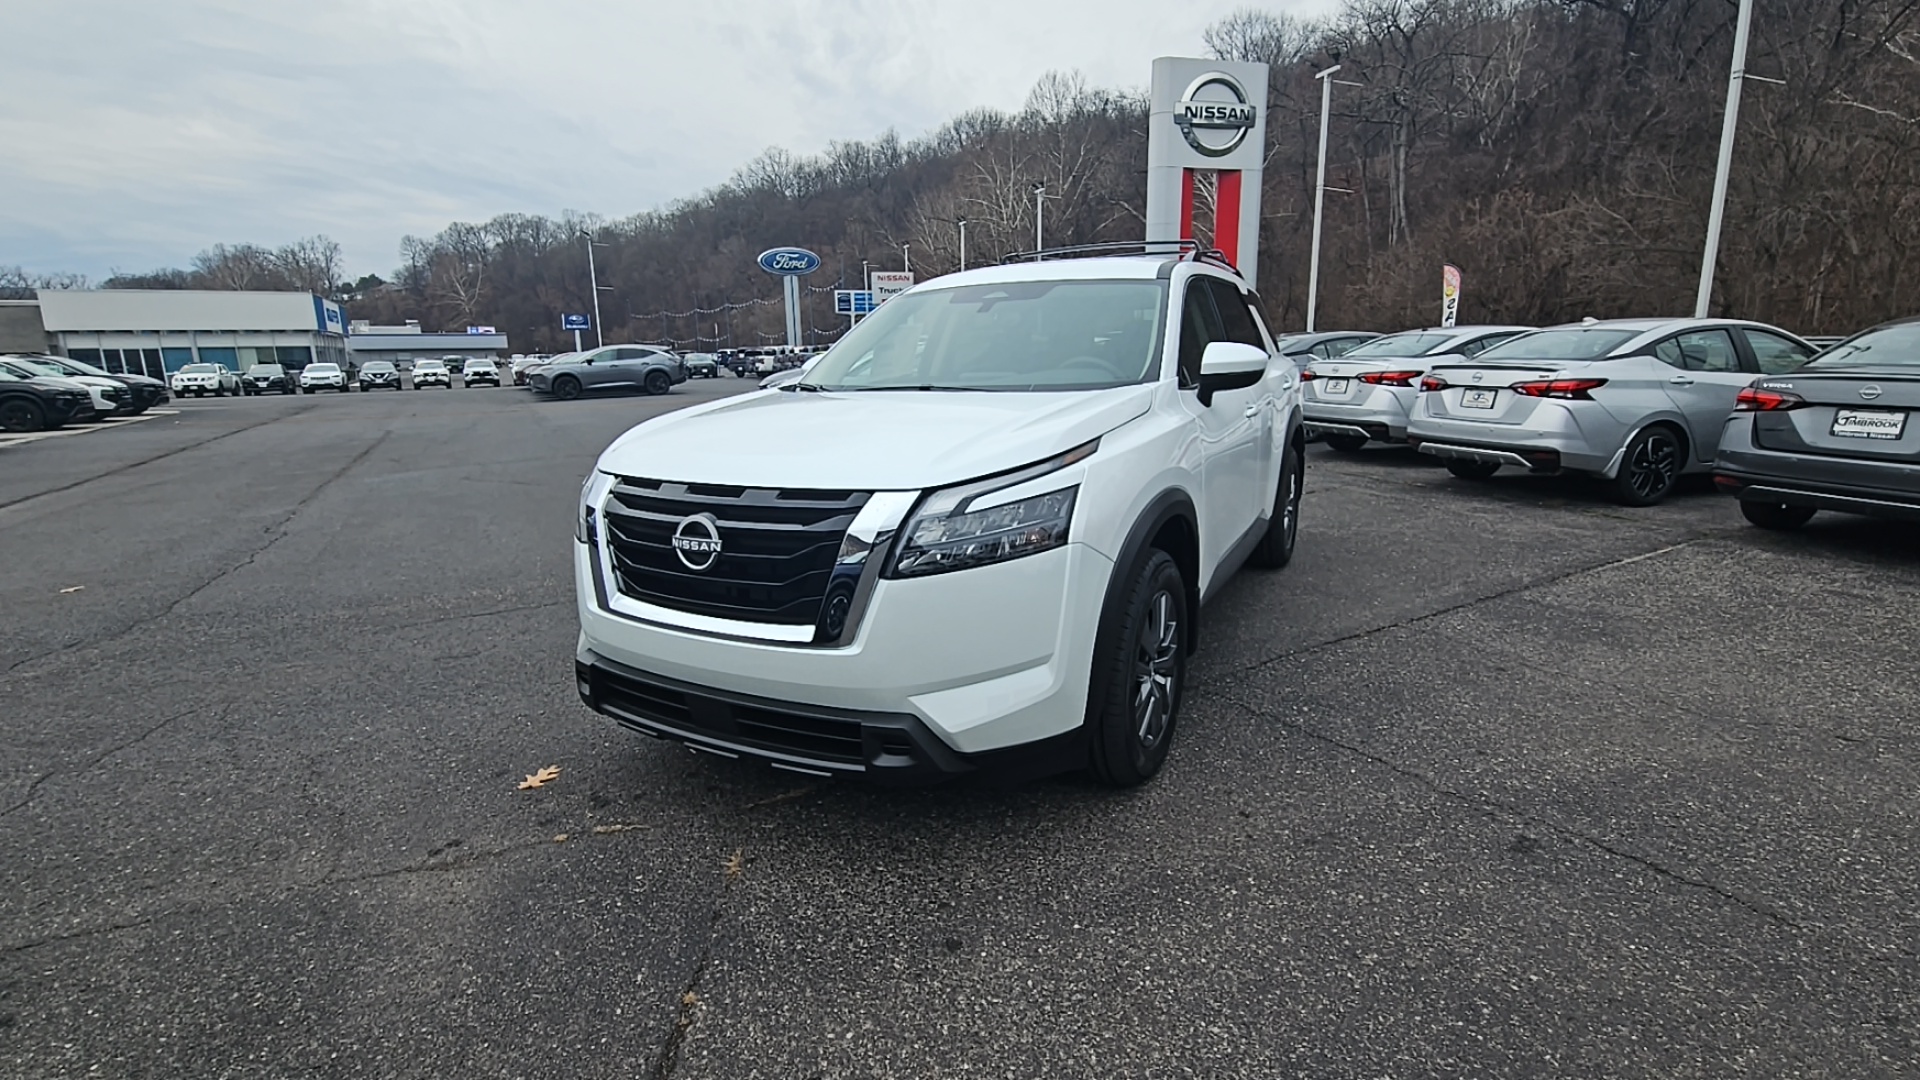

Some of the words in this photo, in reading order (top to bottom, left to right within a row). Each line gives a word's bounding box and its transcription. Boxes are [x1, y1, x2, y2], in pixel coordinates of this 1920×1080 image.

[1184, 105, 1251, 121] NISSAN
[773, 252, 808, 269] Ford
[877, 274, 910, 282] NISSAN
[672, 537, 721, 552] NISSAN
